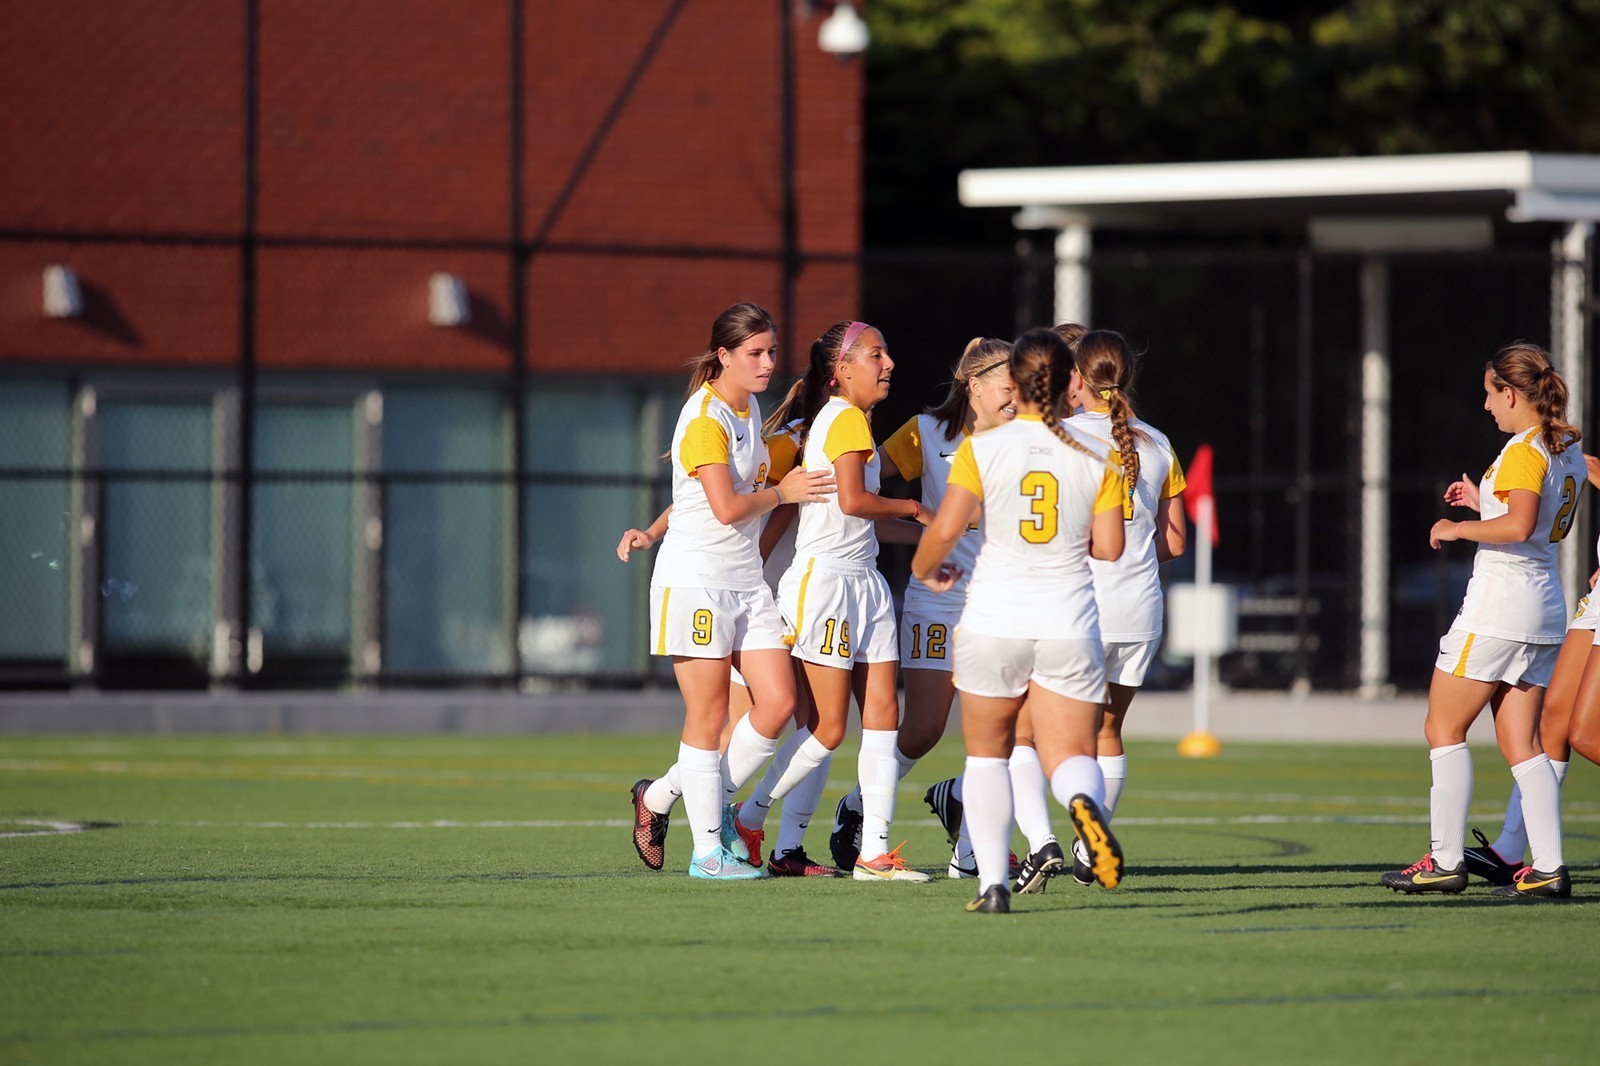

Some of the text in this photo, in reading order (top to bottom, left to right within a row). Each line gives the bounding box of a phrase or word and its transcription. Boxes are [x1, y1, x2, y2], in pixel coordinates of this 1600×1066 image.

[1019, 470, 1059, 544] 3
[1548, 475, 1588, 543] 2
[692, 608, 713, 645] 9
[820, 617, 851, 658] 19
[911, 623, 947, 659] 12
